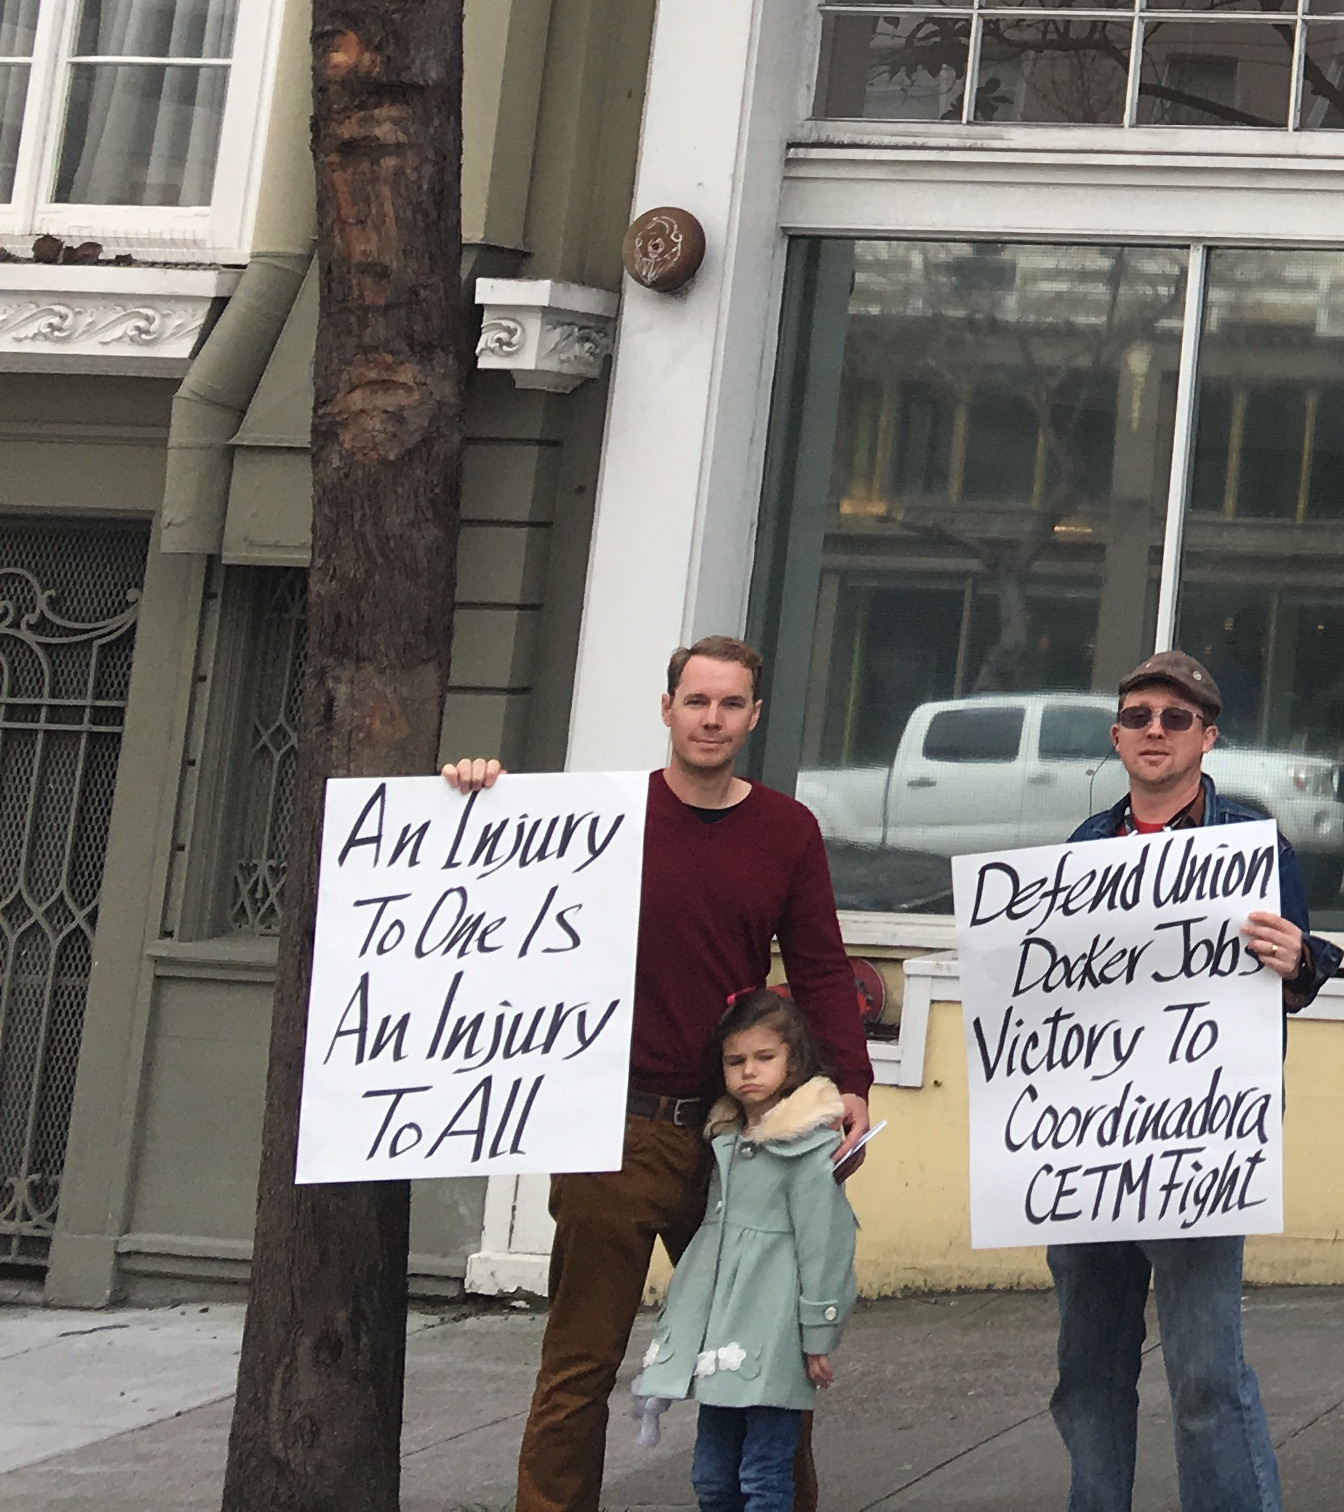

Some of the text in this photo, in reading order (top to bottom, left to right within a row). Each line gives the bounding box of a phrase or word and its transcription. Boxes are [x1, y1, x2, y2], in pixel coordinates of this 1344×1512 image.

[337, 782, 625, 880] An Injury
[353, 885, 583, 959] To One Is
[969, 835, 1275, 937] Defend Union
[1011, 916, 1265, 997] Docker Jobs
[323, 970, 620, 1074] An Injury
[972, 1001, 1219, 1083] Victory To
[361, 1074, 545, 1164] To All
[1004, 1065, 1272, 1153] Coordinadora
[1024, 1146, 1267, 1230] CETM Fight
